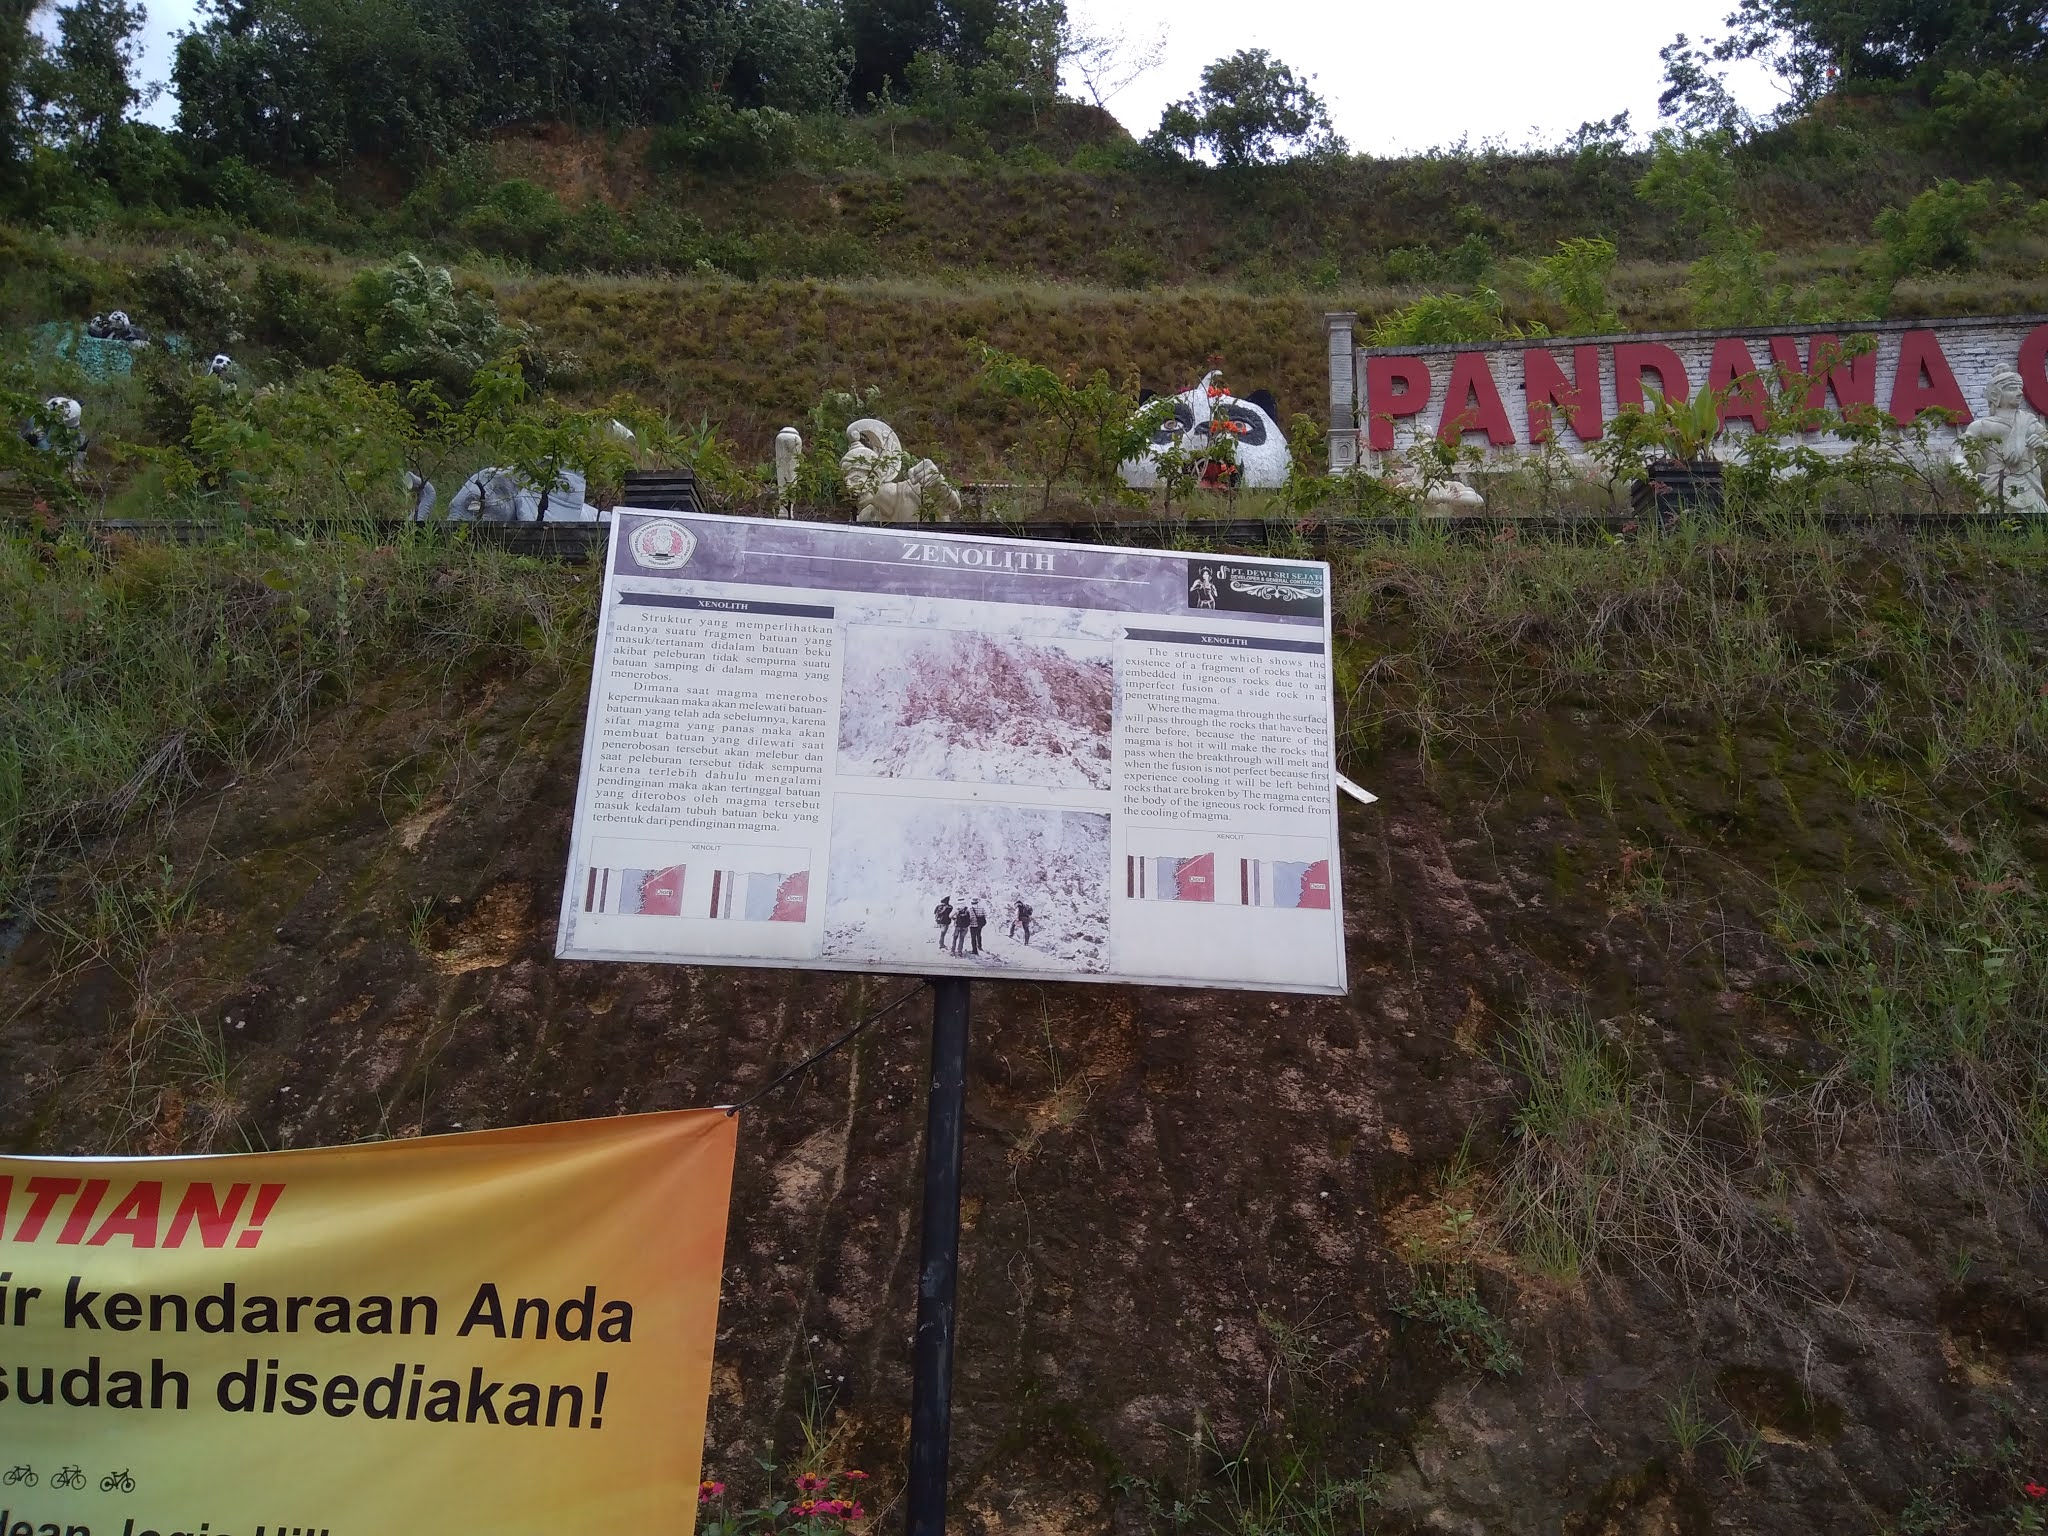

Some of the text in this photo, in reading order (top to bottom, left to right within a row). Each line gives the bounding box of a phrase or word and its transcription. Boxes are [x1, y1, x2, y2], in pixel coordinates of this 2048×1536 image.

[1366, 328, 1974, 452] PANDAWA
[901, 543, 1056, 571] ZENOLITH
[1246, 569, 1272, 578] DEWI
[1274, 571, 1289, 579] SRI
[698, 600, 749, 610] XENOLITH
[640, 612, 833, 635] Struktur yang memperlihatkan
[615, 622, 832, 646] adanya suatu fragmen batuan yang
[1201, 636, 1248, 646] XENOLITH
[710, 639, 755, 651] didalam
[761, 642, 798, 653] batuan
[804, 645, 831, 656] beku
[1148, 646, 1167, 656] The
[1174, 648, 1223, 660] structure
[1229, 652, 1263, 663] which
[1269, 655, 1302, 666] shows
[611, 656, 647, 667] batuan
[653, 659, 699, 672] samping
[721, 663, 754, 674] dalam
[759, 668, 798, 679] magma
[804, 670, 829, 681] yang
[1125, 655, 1170, 667] existence
[1201, 661, 1244, 675] fragment
[1264, 666, 1290, 676] rocks
[1294, 668, 1313, 678] that
[1125, 666, 1176, 679] embedded
[1198, 672, 1236, 685] igneous
[1242, 675, 1269, 686] rocks
[1274, 678, 1292, 687] due
[606, 691, 679, 706] kepermukaan
[681, 695, 710, 706] maka
[711, 697, 737, 708] akan
[738, 699, 787, 711] melewati
[633, 681, 828, 702] Dimana saat magma menerobos
[1124, 689, 1180, 704] penetrating
[1147, 702, 1179, 713] Where
[1181, 704, 1196, 714] the
[1198, 708, 1234, 719] magma
[1236, 708, 1274, 721] through
[1275, 711, 1290, 720] the
[604, 714, 825, 737] sifat magma yang panas maka akan
[1124, 723, 1149, 734] there
[1195, 728, 1234, 739] because
[1239, 731, 1255, 741] the
[1260, 732, 1291, 743] nature
[600, 738, 823, 760] penerobosan tersebut akan melebur dan
[1124, 737, 1161, 748] magma
[1177, 738, 1193, 748] hot
[1208, 740, 1227, 750] will
[1230, 742, 1257, 752] make
[1260, 743, 1277, 753] the
[1280, 745, 1306, 755] rocks
[599, 750, 822, 775] saat peleburan tersebut tidak sempurna
[1123, 749, 1145, 759] pass
[1148, 748, 1175, 758] when
[1178, 750, 1194, 759] the
[1196, 751, 1262, 766] breakthrough
[1264, 755, 1284, 765] will
[1286, 757, 1309, 767] melt
[598, 762, 821, 787] karena terlebih dahulu mengalami
[1123, 769, 1177, 784] experience
[1181, 773, 1219, 786] cooling
[1235, 776, 1255, 786] will
[1275, 779, 1292, 789] left
[594, 789, 819, 809] yang diterobos oleh magma tersebut
[1123, 793, 1139, 803] the
[1142, 794, 1166, 807] body
[1183, 797, 1199, 807] the
[1202, 798, 1241, 811] igneous
[1242, 800, 1265, 810] rock
[1268, 802, 1304, 813] formed
[591, 811, 644, 824] terbentuk
[645, 814, 667, 825] dari
[668, 815, 738, 831] pendinginan
[1123, 805, 1139, 815] the
[1140, 806, 1178, 820] cooling
[64, 1276, 439, 1336] kendaraan
[456, 1283, 635, 1343] Anda
[0, 1356, 610, 1429] udah disediakan!
